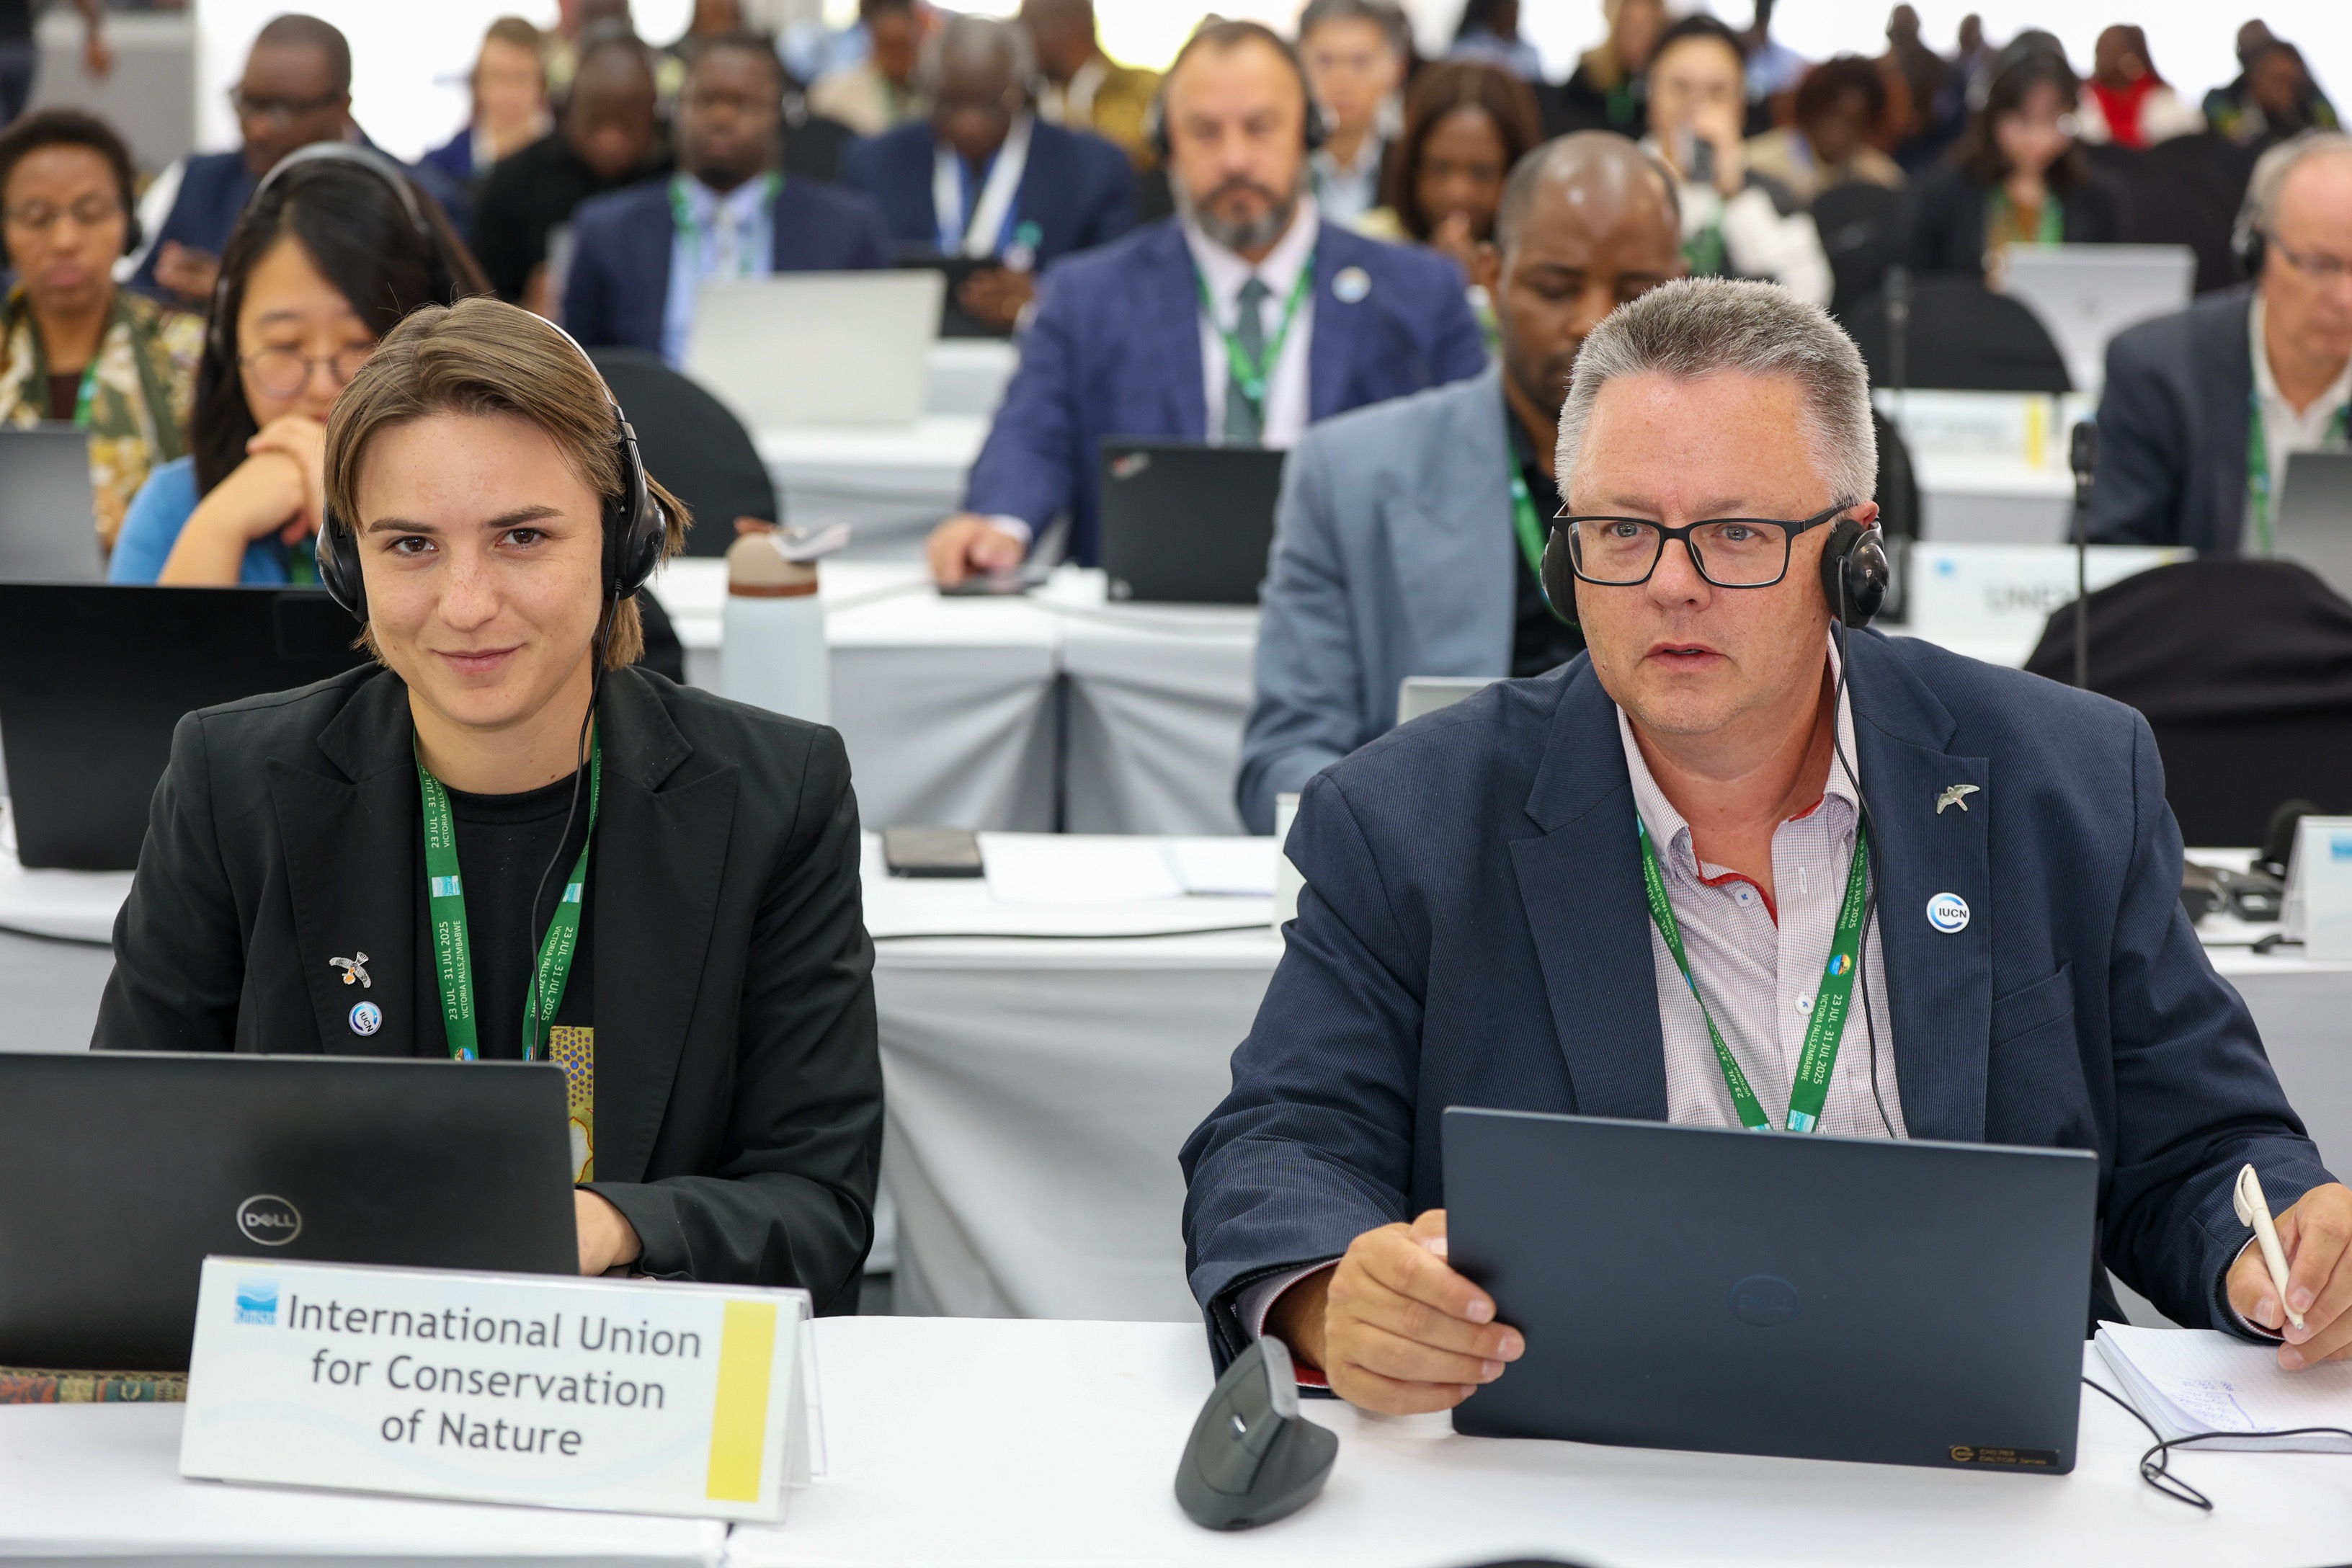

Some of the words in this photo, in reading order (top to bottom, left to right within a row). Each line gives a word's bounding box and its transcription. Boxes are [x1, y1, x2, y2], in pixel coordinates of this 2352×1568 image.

[425, 778, 435, 794] JUL
[428, 796, 437, 808] 31
[429, 816, 438, 834] JUL
[441, 814, 450, 848] VICTORIA
[431, 836, 440, 848] 23
[1856, 876, 1863, 887] 31
[1646, 883, 1656, 901] JUL
[1652, 901, 1661, 914] 31
[1939, 908, 1967, 919] IUCN
[1848, 906, 1859, 929] 2025
[439, 921, 450, 946] 2025
[564, 927, 574, 938] 23
[1661, 919, 1670, 936] JUL
[1665, 912, 1679, 945] VICTORIA
[545, 925, 562, 956] VICTORIA
[558, 940, 569, 956] JUL
[1668, 937, 1675, 949] 23
[442, 948, 453, 966] JUL
[453, 920, 466, 983] FALLS,ZIMBABWE
[444, 968, 453, 980] 31
[553, 965, 564, 976] 31
[548, 979, 560, 994] JUL
[446, 988, 456, 1006] JUL
[460, 984, 469, 1020] VICTORIA
[1832, 994, 1843, 1006] 23
[448, 1007, 458, 1020] 23
[541, 997, 555, 1021] 2025
[1815, 994, 1830, 1023] VICTORIA
[1828, 1007, 1840, 1023] JUL
[360, 1012, 373, 1032] IUCN
[1823, 1030, 1834, 1041] 31
[1720, 1051, 1728, 1061] 31
[1801, 1024, 1822, 1082] FALLS,ZIMBABWE
[1819, 1043, 1831, 1059] JUL
[1728, 1069, 1738, 1085] JUL
[1813, 1060, 1827, 1085] 2025
[1734, 1067, 1751, 1097] VICTORIA
[1734, 1087, 1745, 1099] 23
[245, 1213, 295, 1228] DELL
[288, 1294, 562, 1349] International
[579, 1316, 702, 1358] Union
[311, 1348, 371, 1387] for
[386, 1354, 664, 1409] Conservation
[380, 1409, 425, 1443] of
[438, 1412, 583, 1456] Nature
